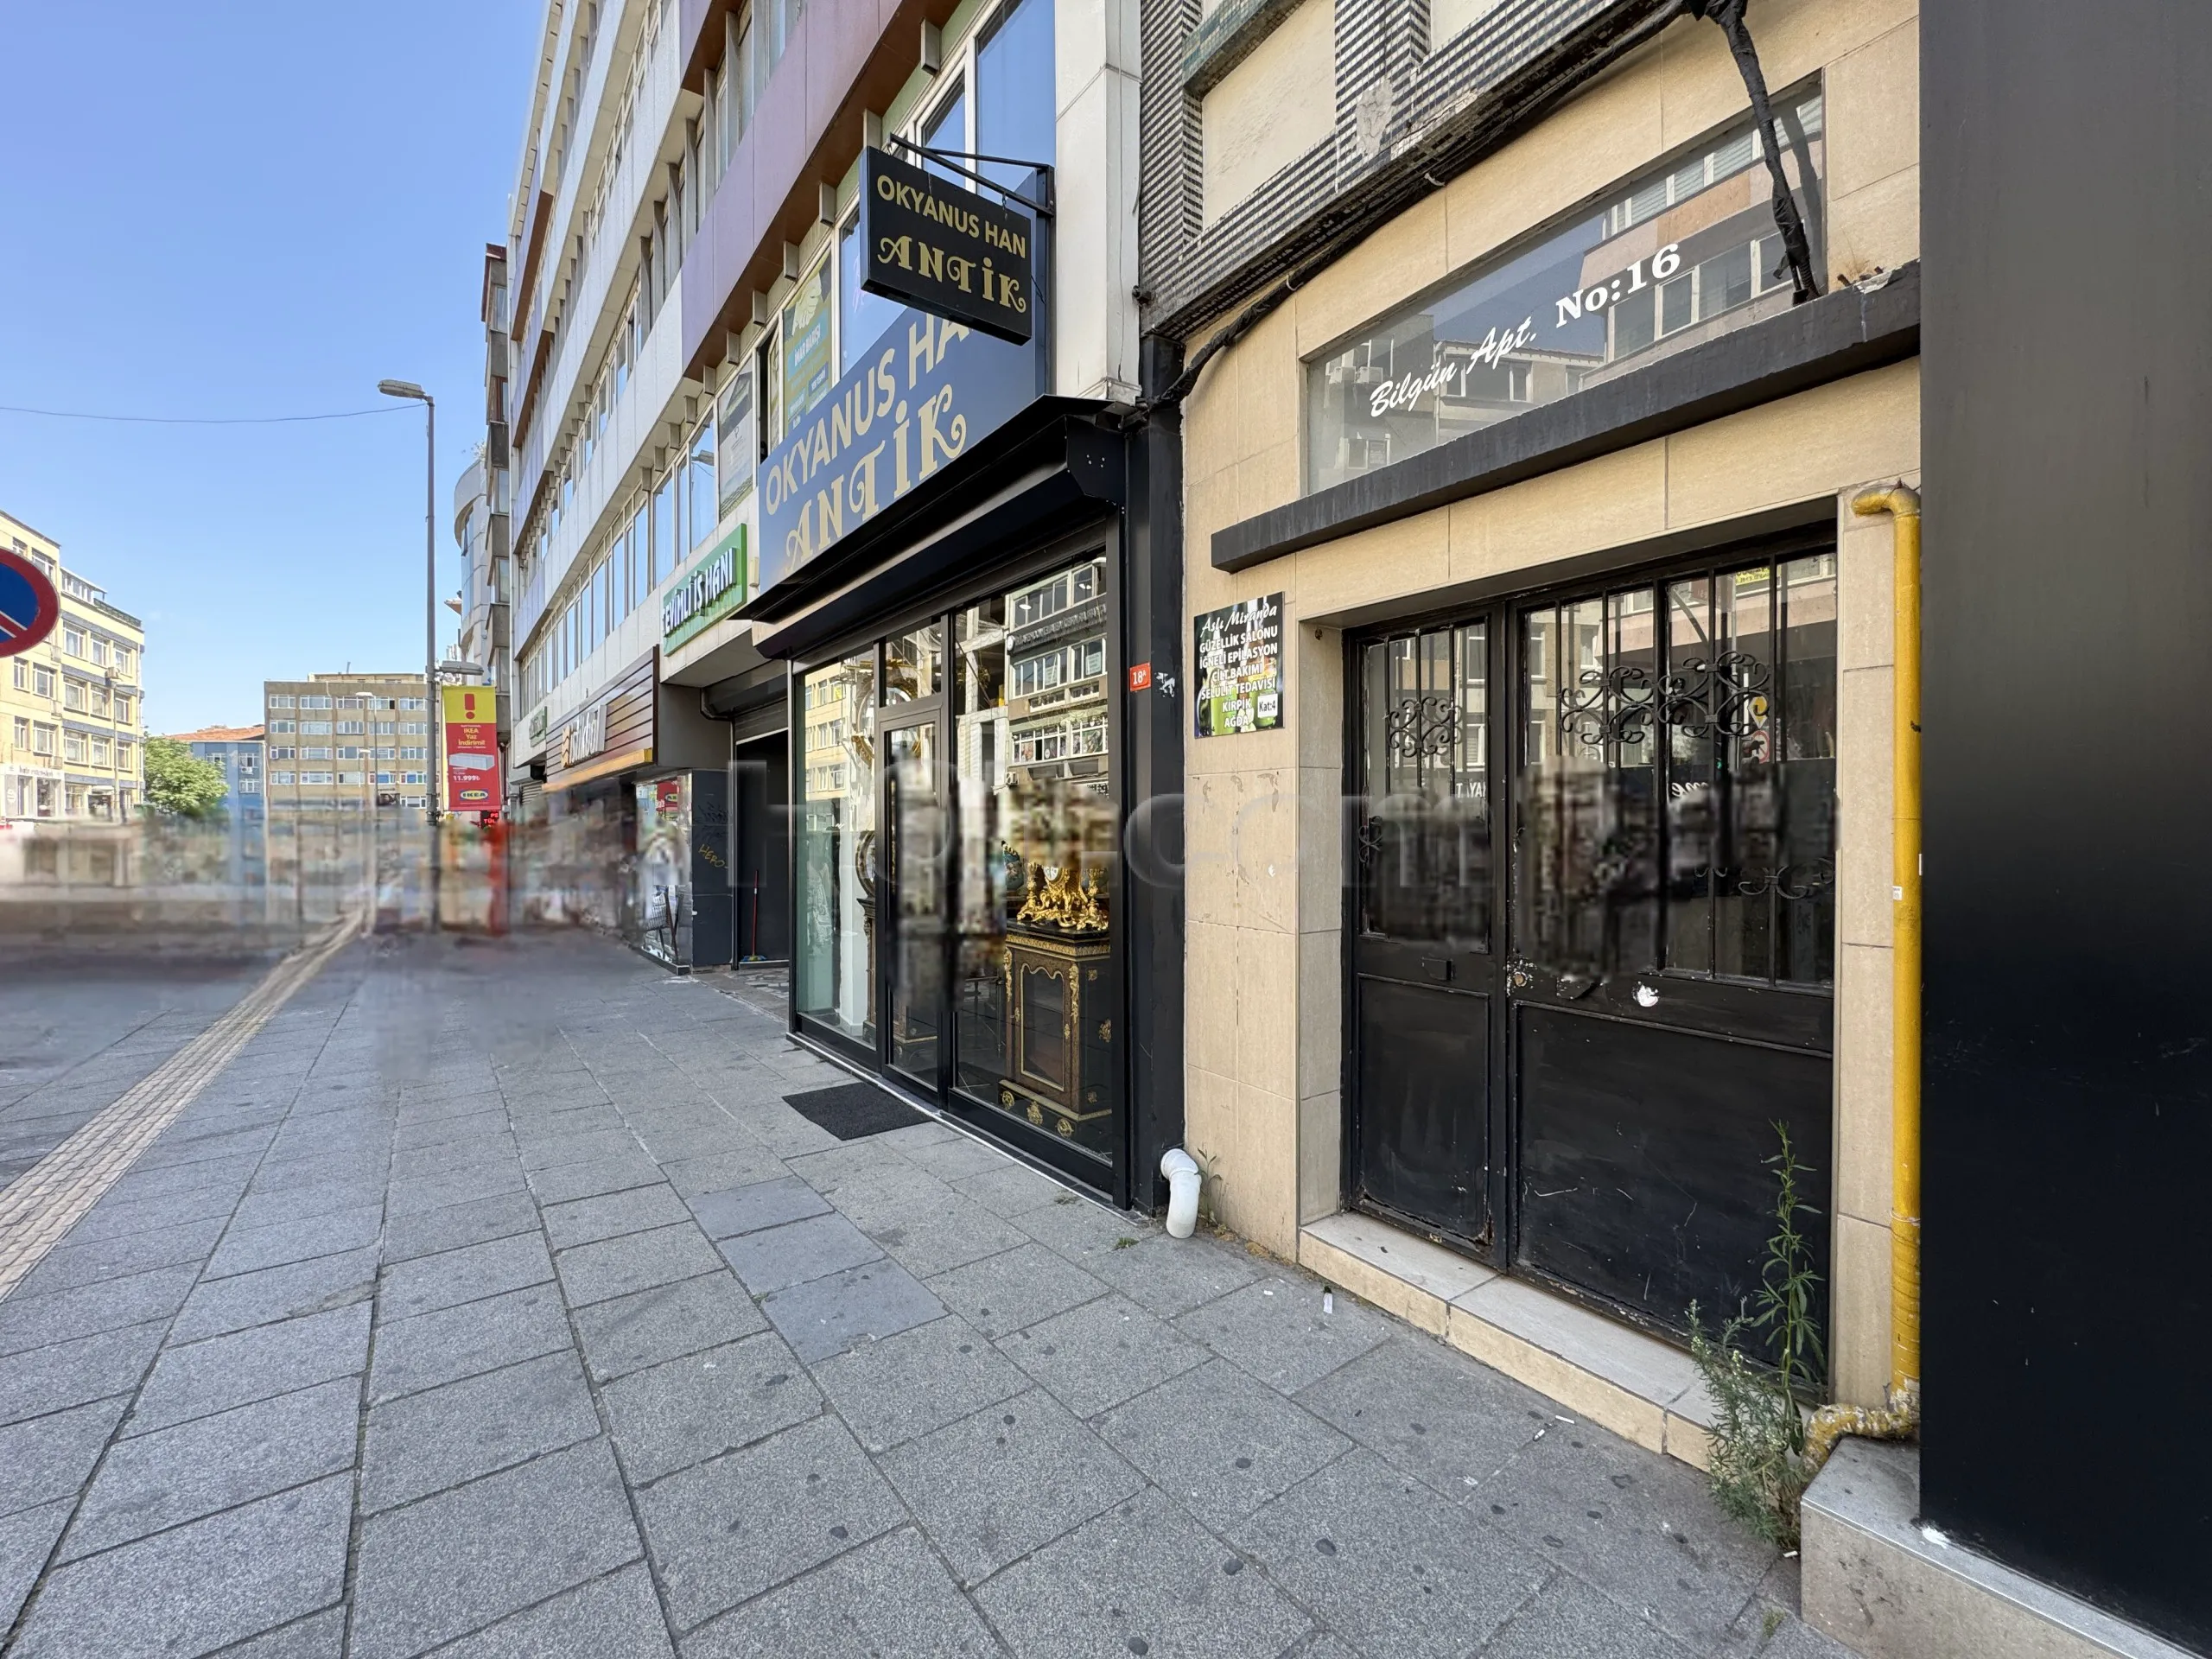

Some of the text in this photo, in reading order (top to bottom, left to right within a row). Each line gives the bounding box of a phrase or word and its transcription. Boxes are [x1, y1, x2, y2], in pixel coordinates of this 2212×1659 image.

[877, 175, 1026, 259] OKYANUS HAN
[877, 235, 1027, 314] ANTİK
[1370, 242, 1681, 417] Bilgün Apt. No:16
[766, 313, 974, 516] OKYANUS HA
[785, 383, 967, 574] ANTİK
[1201, 602, 1278, 638] Aslı Miranda
[1199, 625, 1278, 654] GÜZELLİK SALONU
[1199, 642, 1278, 670] İĞNELİ EPİLASYON
[1211, 662, 1262, 683] CİLT BAKIMI
[1201, 674, 1276, 701] SELÜLİT TEDAVİSİ
[1222, 697, 1252, 713] KİRPİK
[1259, 700, 1276, 712] Kat:4
[1224, 715, 1249, 728] AĞDA
